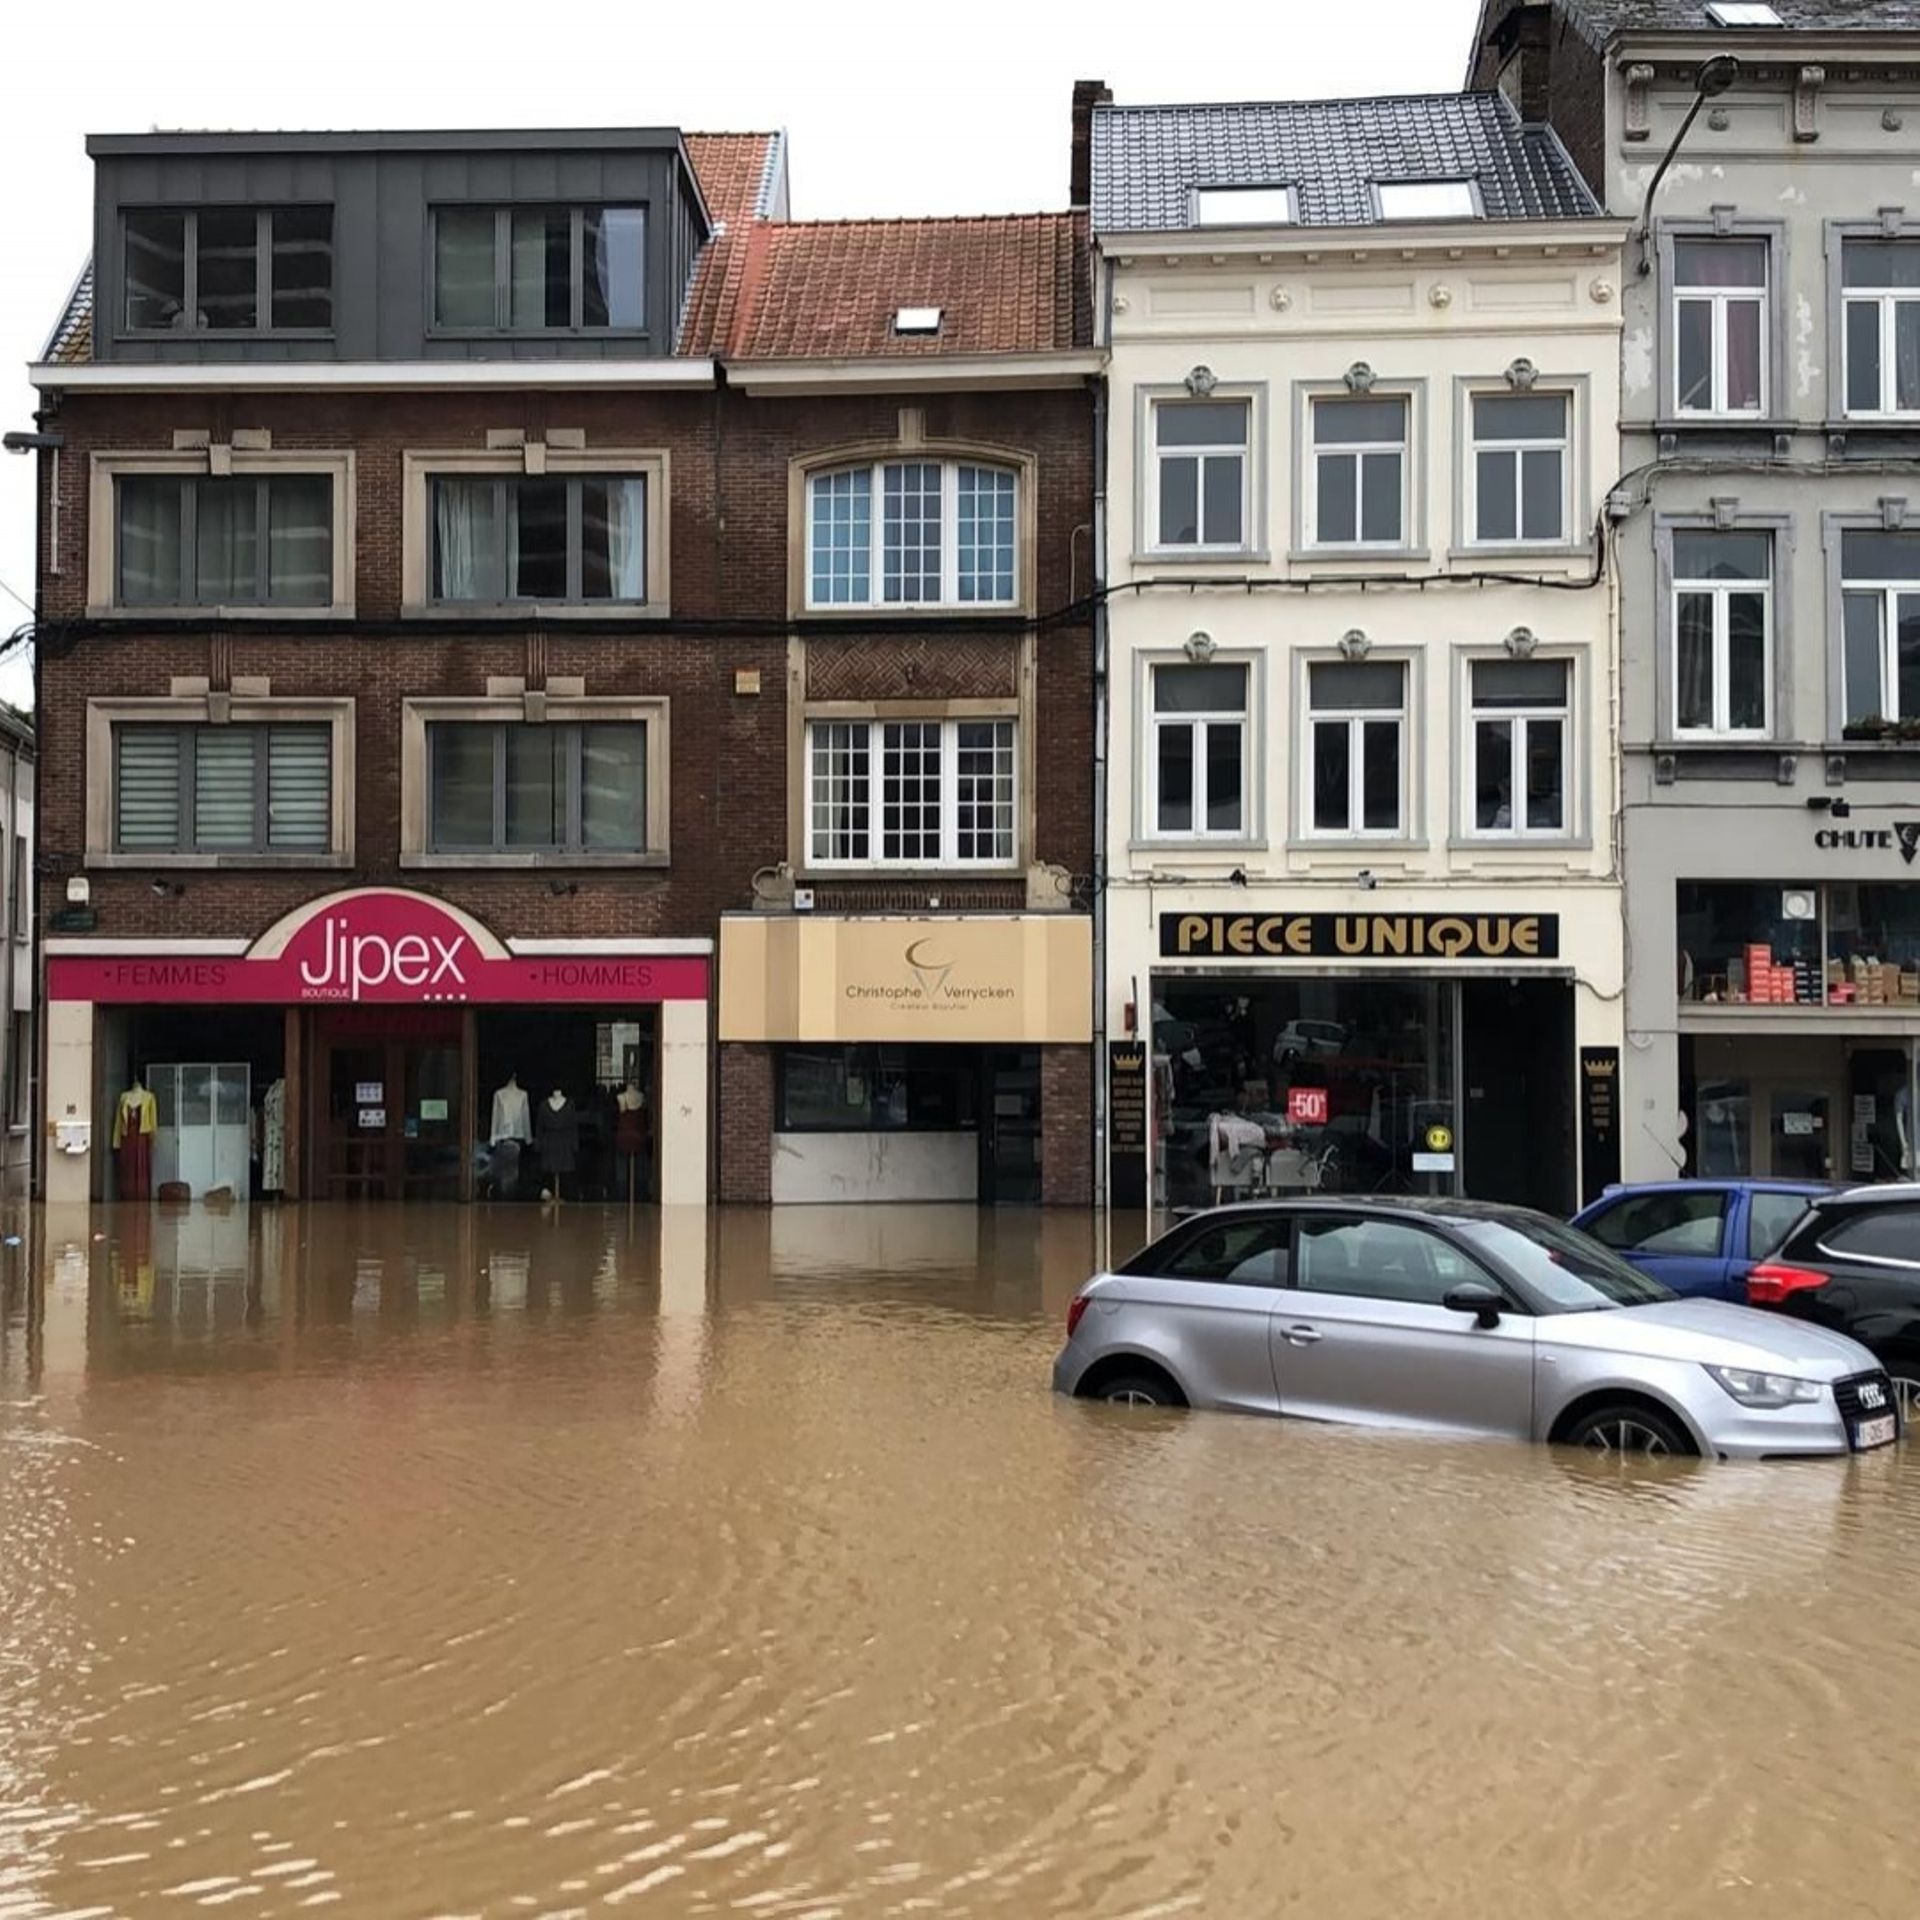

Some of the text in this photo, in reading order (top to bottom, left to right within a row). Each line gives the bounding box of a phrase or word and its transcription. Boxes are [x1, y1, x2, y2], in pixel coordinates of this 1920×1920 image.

[1814, 829, 1892, 849] CHUTE
[1178, 916, 1539, 957] PIECE UNIQUE
[301, 918, 466, 1001] Jipex
[117, 964, 227, 986] FEMMES
[542, 964, 653, 986] HOMMES
[301, 988, 350, 998] BOUTIQUE
[845, 984, 1015, 999] Christophe Verrycken
